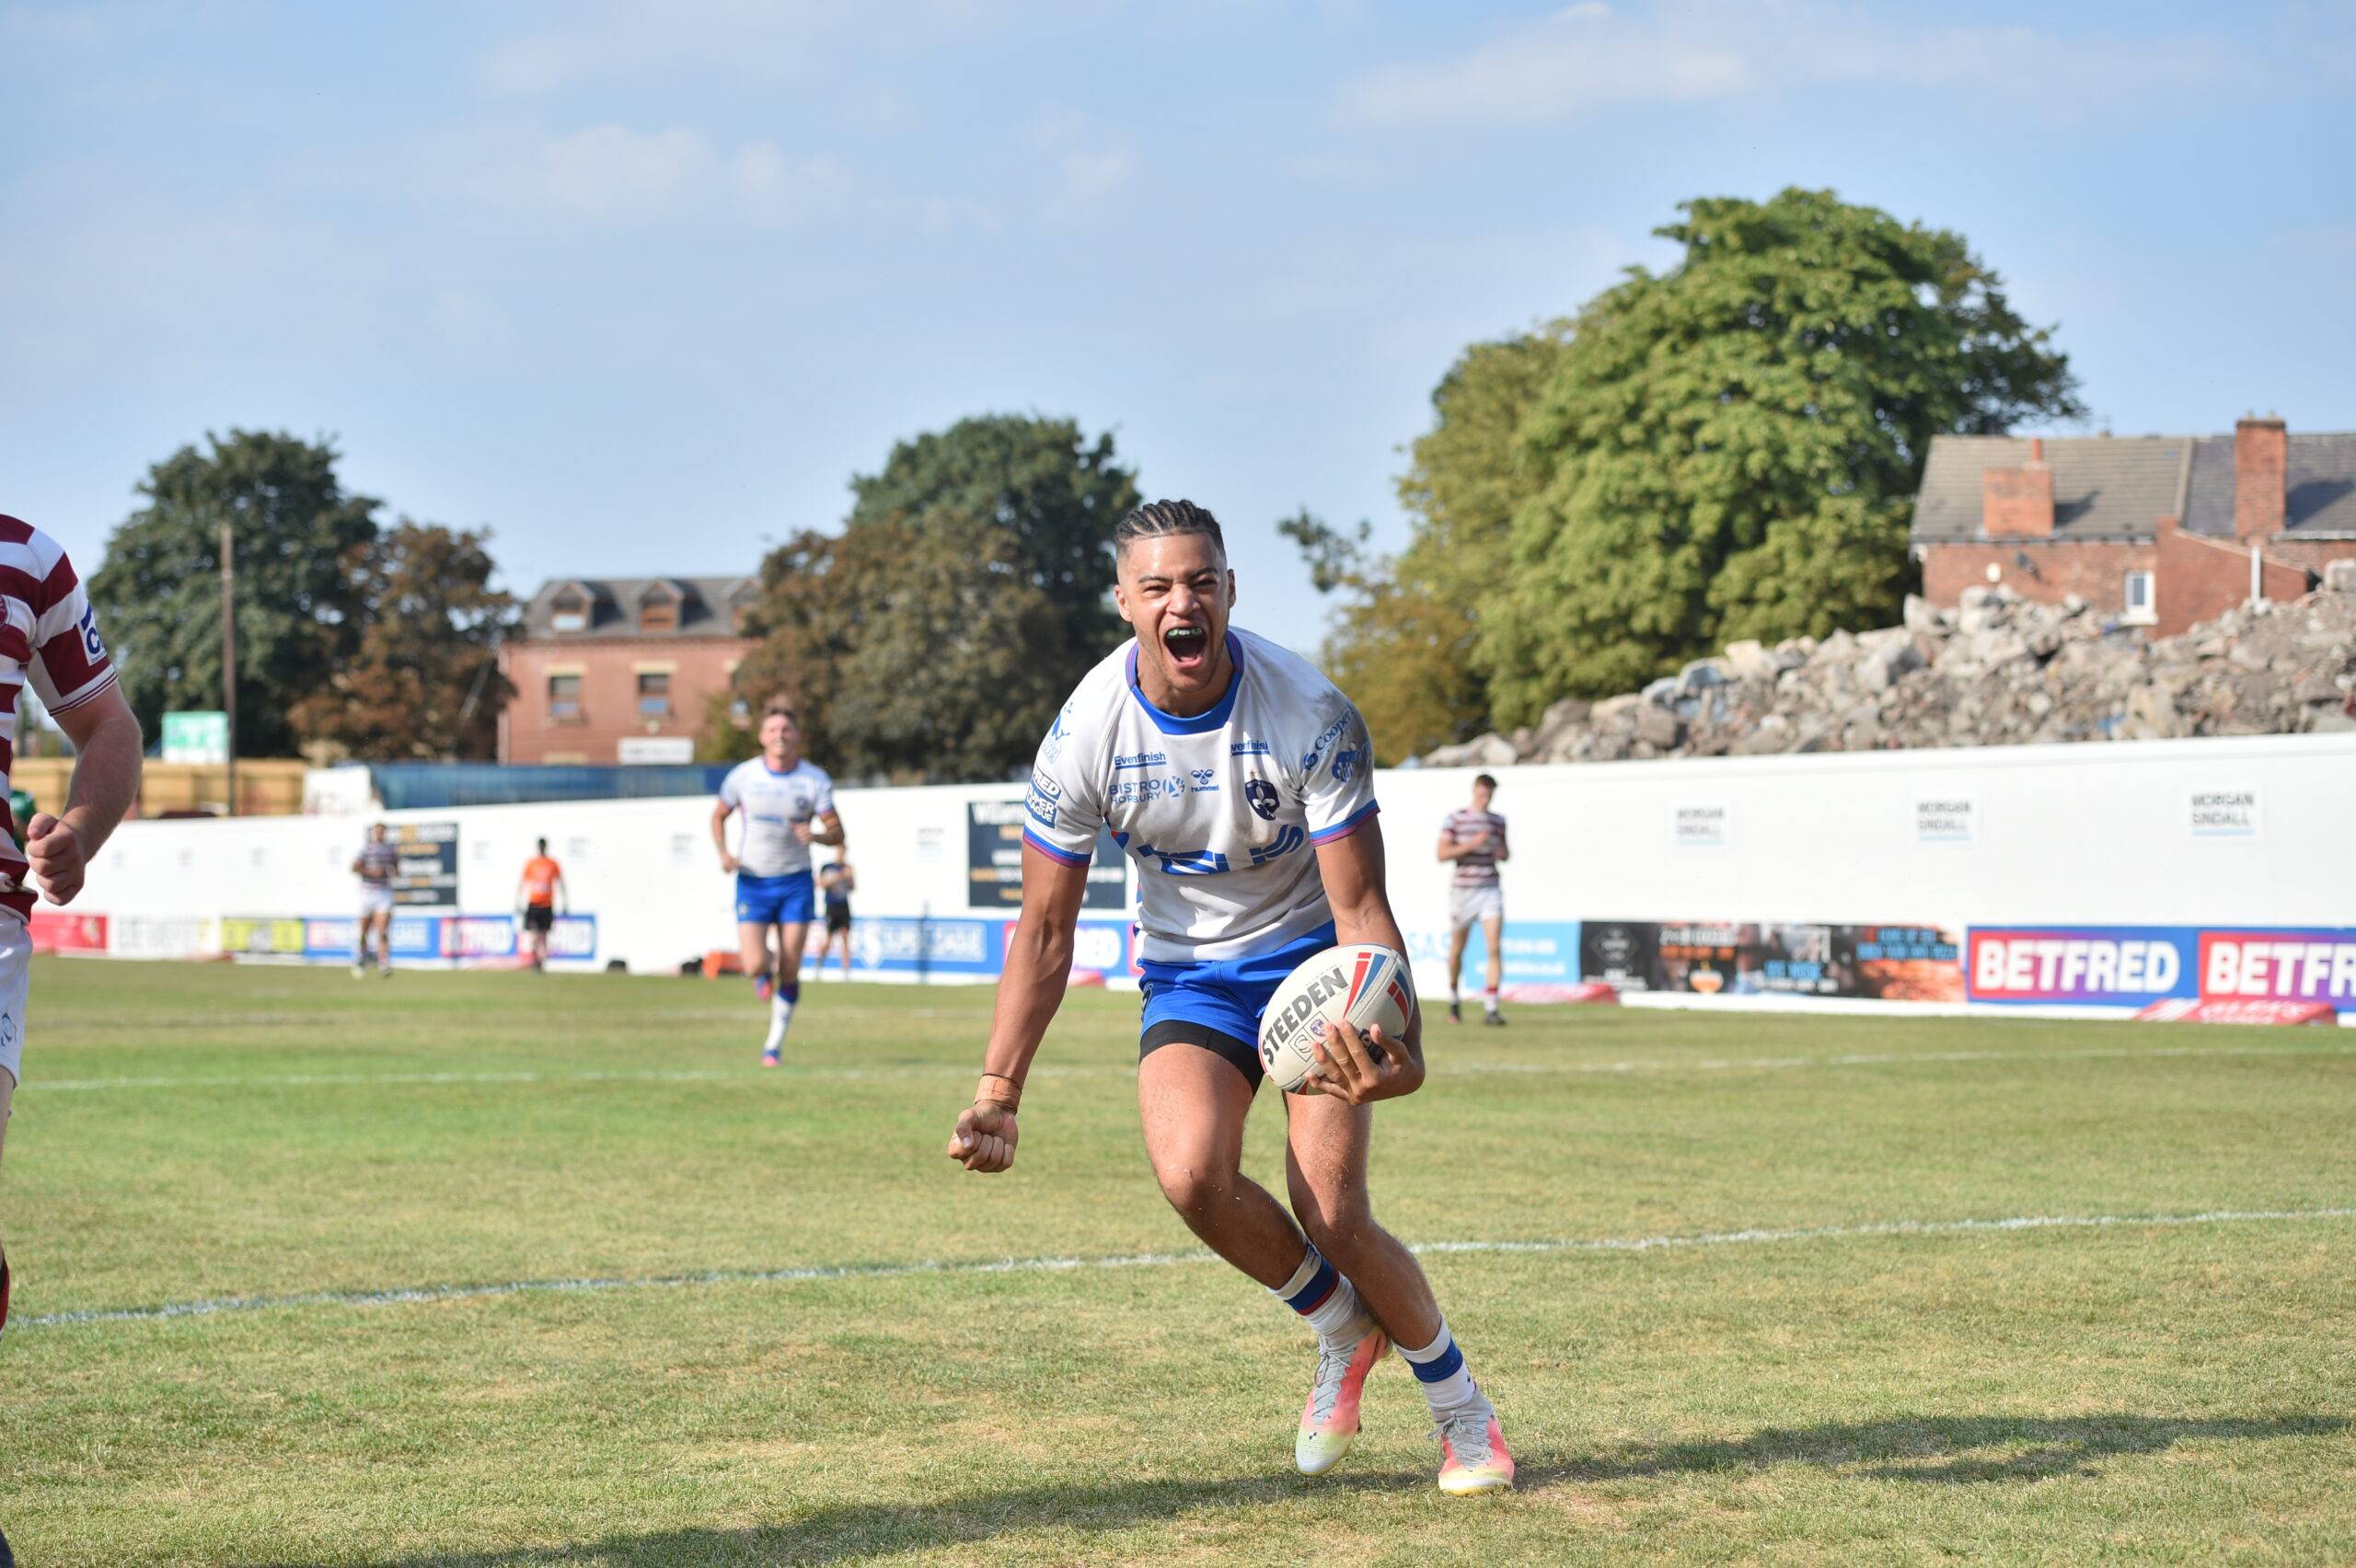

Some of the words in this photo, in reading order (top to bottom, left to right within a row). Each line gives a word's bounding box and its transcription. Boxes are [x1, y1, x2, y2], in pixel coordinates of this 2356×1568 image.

[1114, 752, 1166, 766] Evenfinish
[1109, 779, 1160, 795] BISTRO
[1191, 784, 1219, 793] hummel
[1110, 792, 1161, 805] HORBURY
[1975, 939, 2180, 994] BETFRED
[1262, 966, 1349, 1066] STEEDEN
